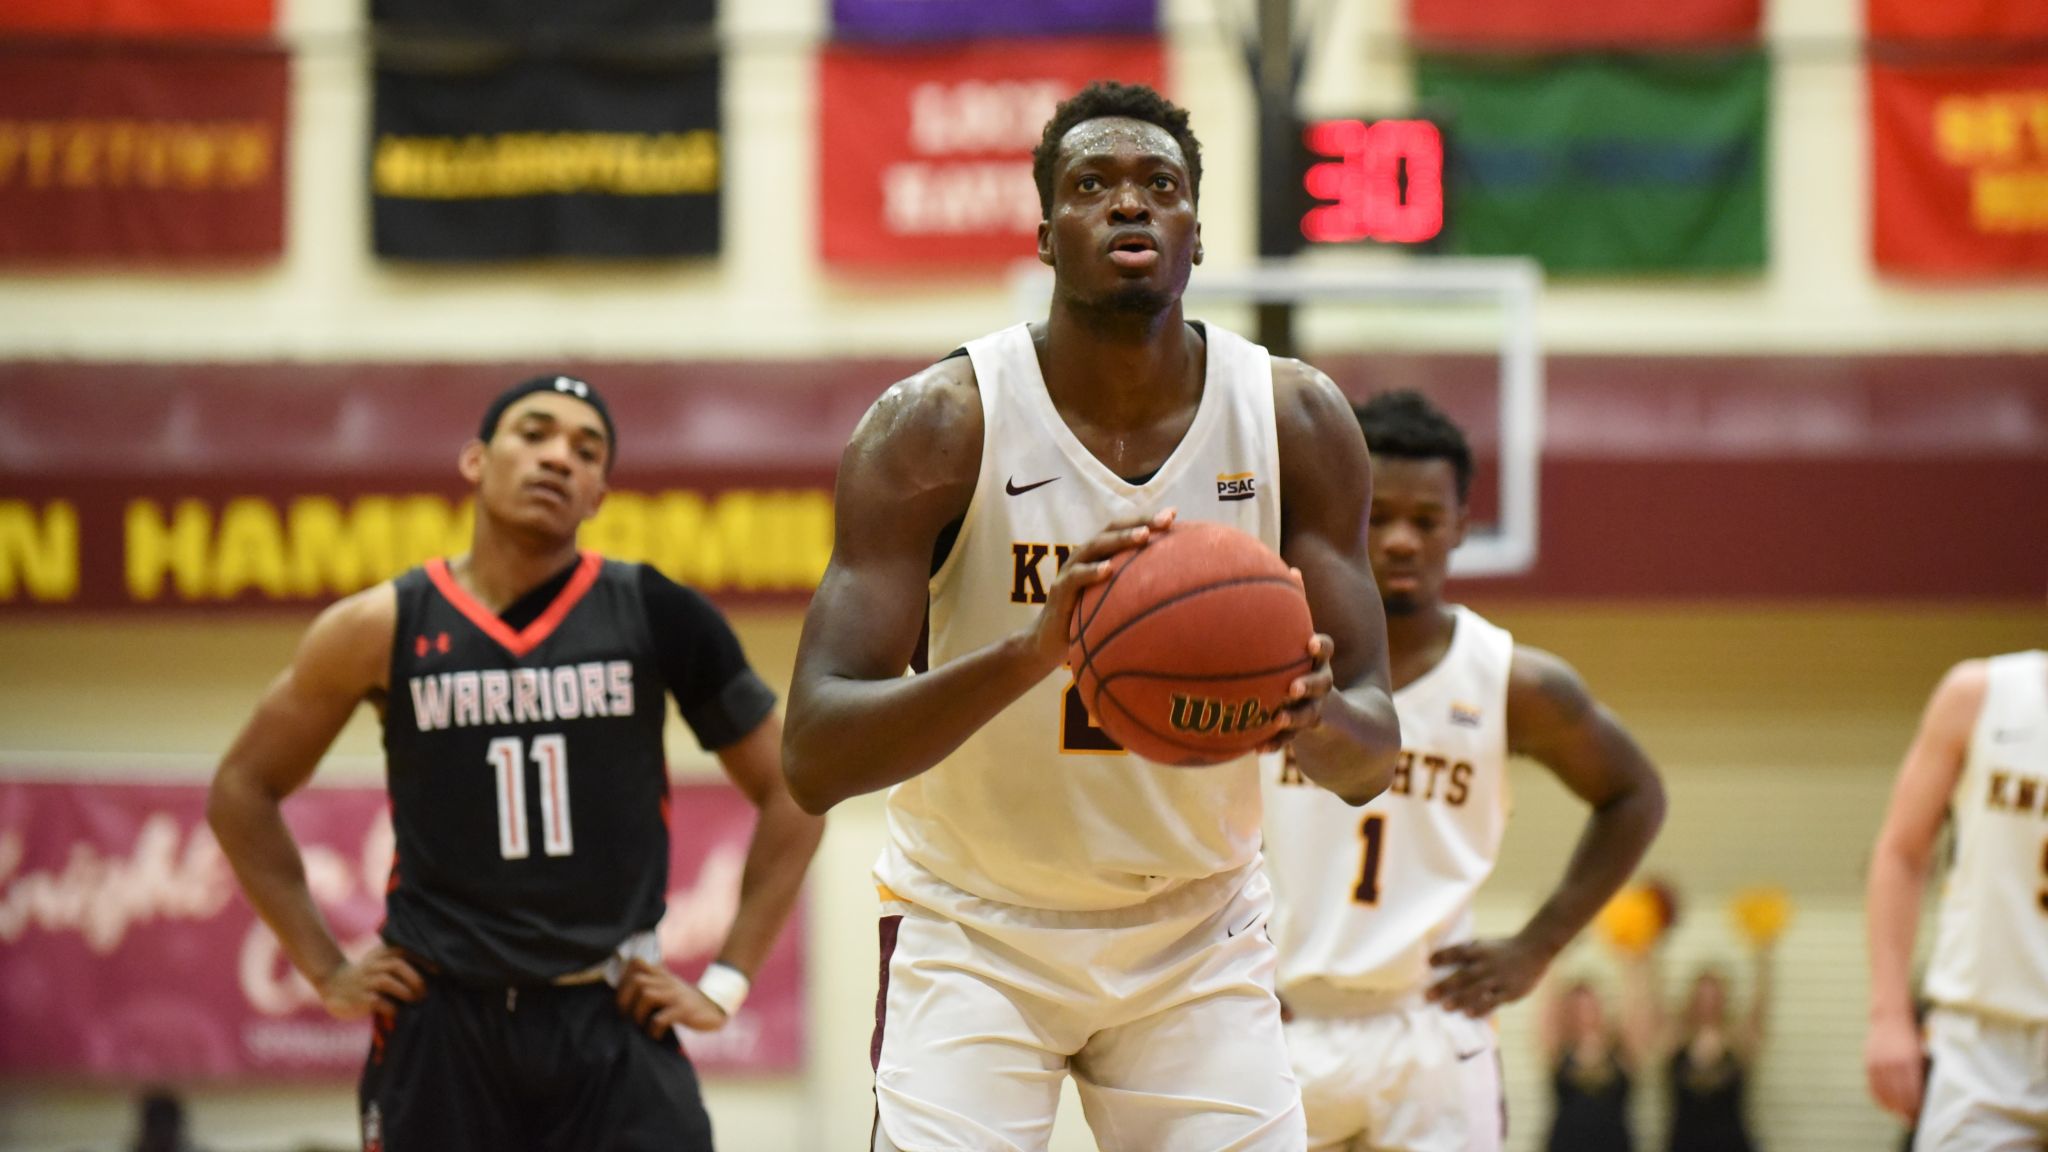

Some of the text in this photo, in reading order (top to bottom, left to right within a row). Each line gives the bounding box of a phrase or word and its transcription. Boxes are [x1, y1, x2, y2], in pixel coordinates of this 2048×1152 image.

[1303, 119, 1444, 243] 30
[1217, 478, 1255, 494] PSAC
[409, 660, 634, 732] WARRIORS
[486, 733, 574, 860] 11
[1351, 813, 1387, 908] 1
